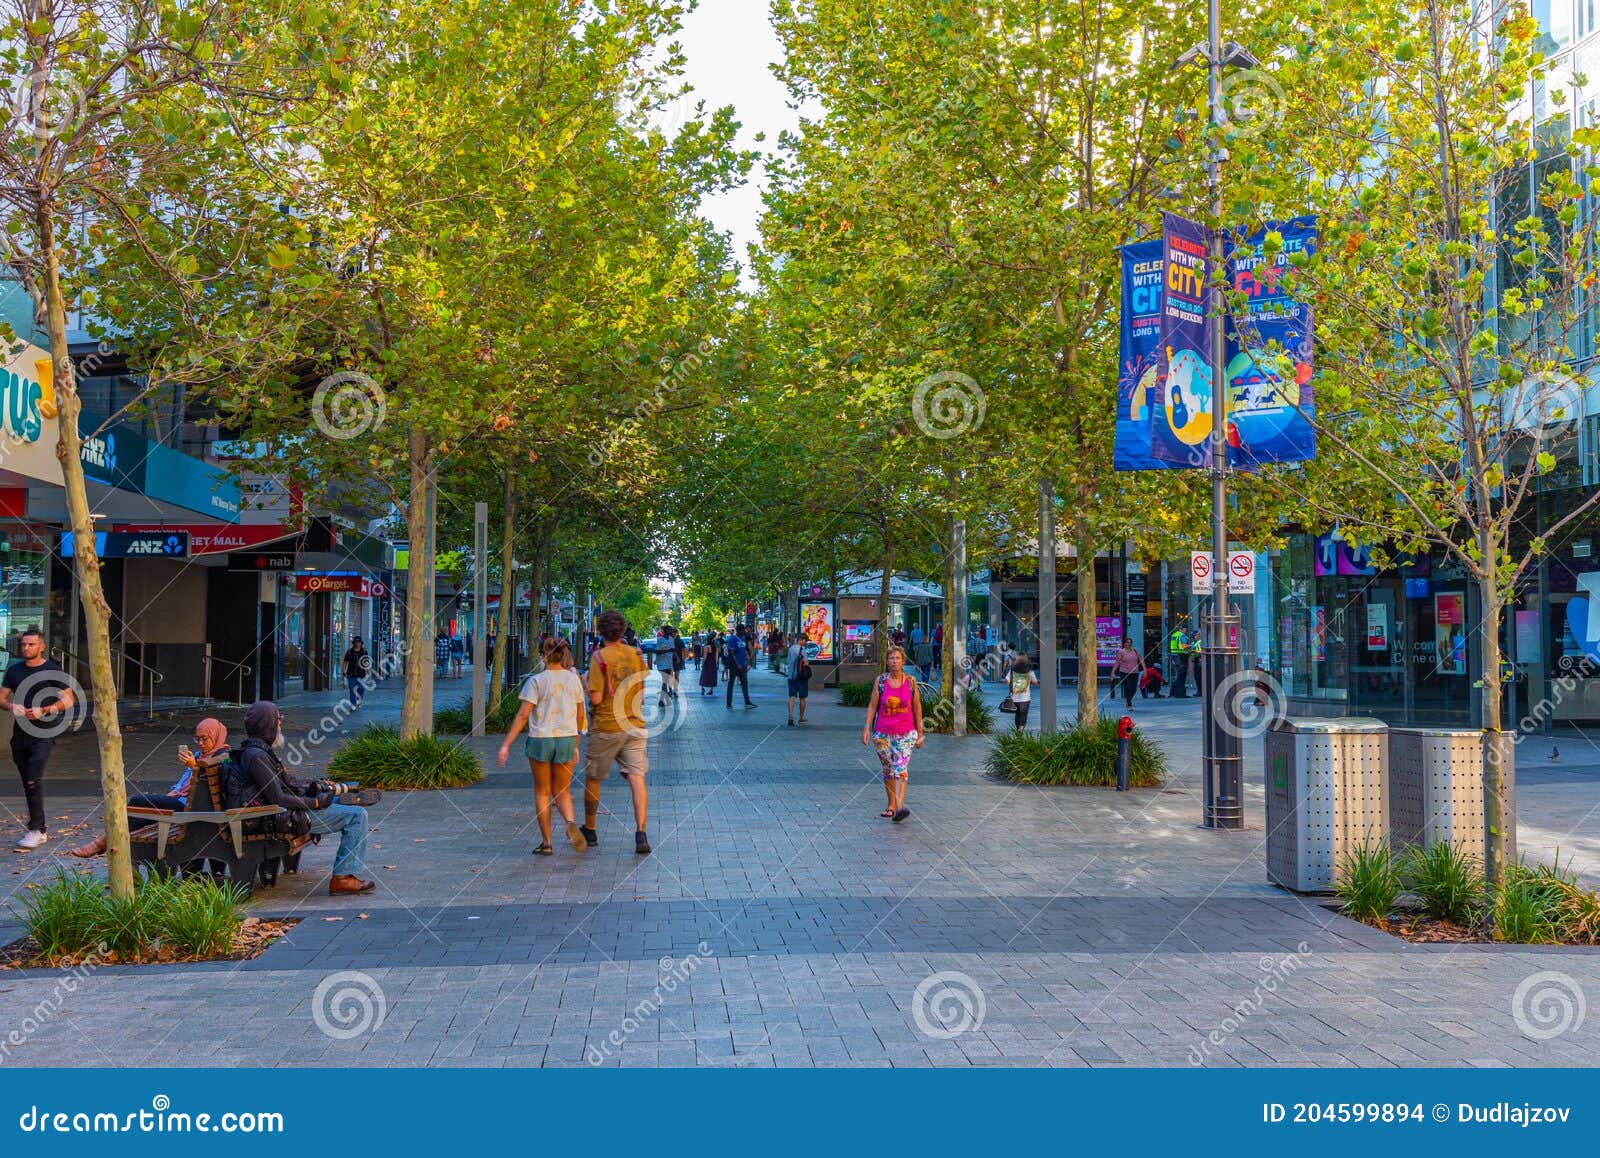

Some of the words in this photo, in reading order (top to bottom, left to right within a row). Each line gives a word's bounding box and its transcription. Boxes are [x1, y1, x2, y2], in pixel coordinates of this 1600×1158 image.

[1169, 235, 1206, 258] CELEBRATE
[1169, 248, 1187, 266] WITH
[1133, 272, 1162, 287] WITH
[1168, 262, 1205, 298] CITY
[1132, 285, 1162, 313] CI
[1166, 296, 1193, 312] AUSTRALIA
[1165, 306, 1180, 319] LONG
[1180, 310, 1204, 326] WEEKEND
[1132, 327, 1152, 338] LONG
[81, 435, 106, 468] ANZ
[127, 540, 163, 554] ANZ
[214, 537, 246, 546] MALL
[269, 556, 292, 567] nab
